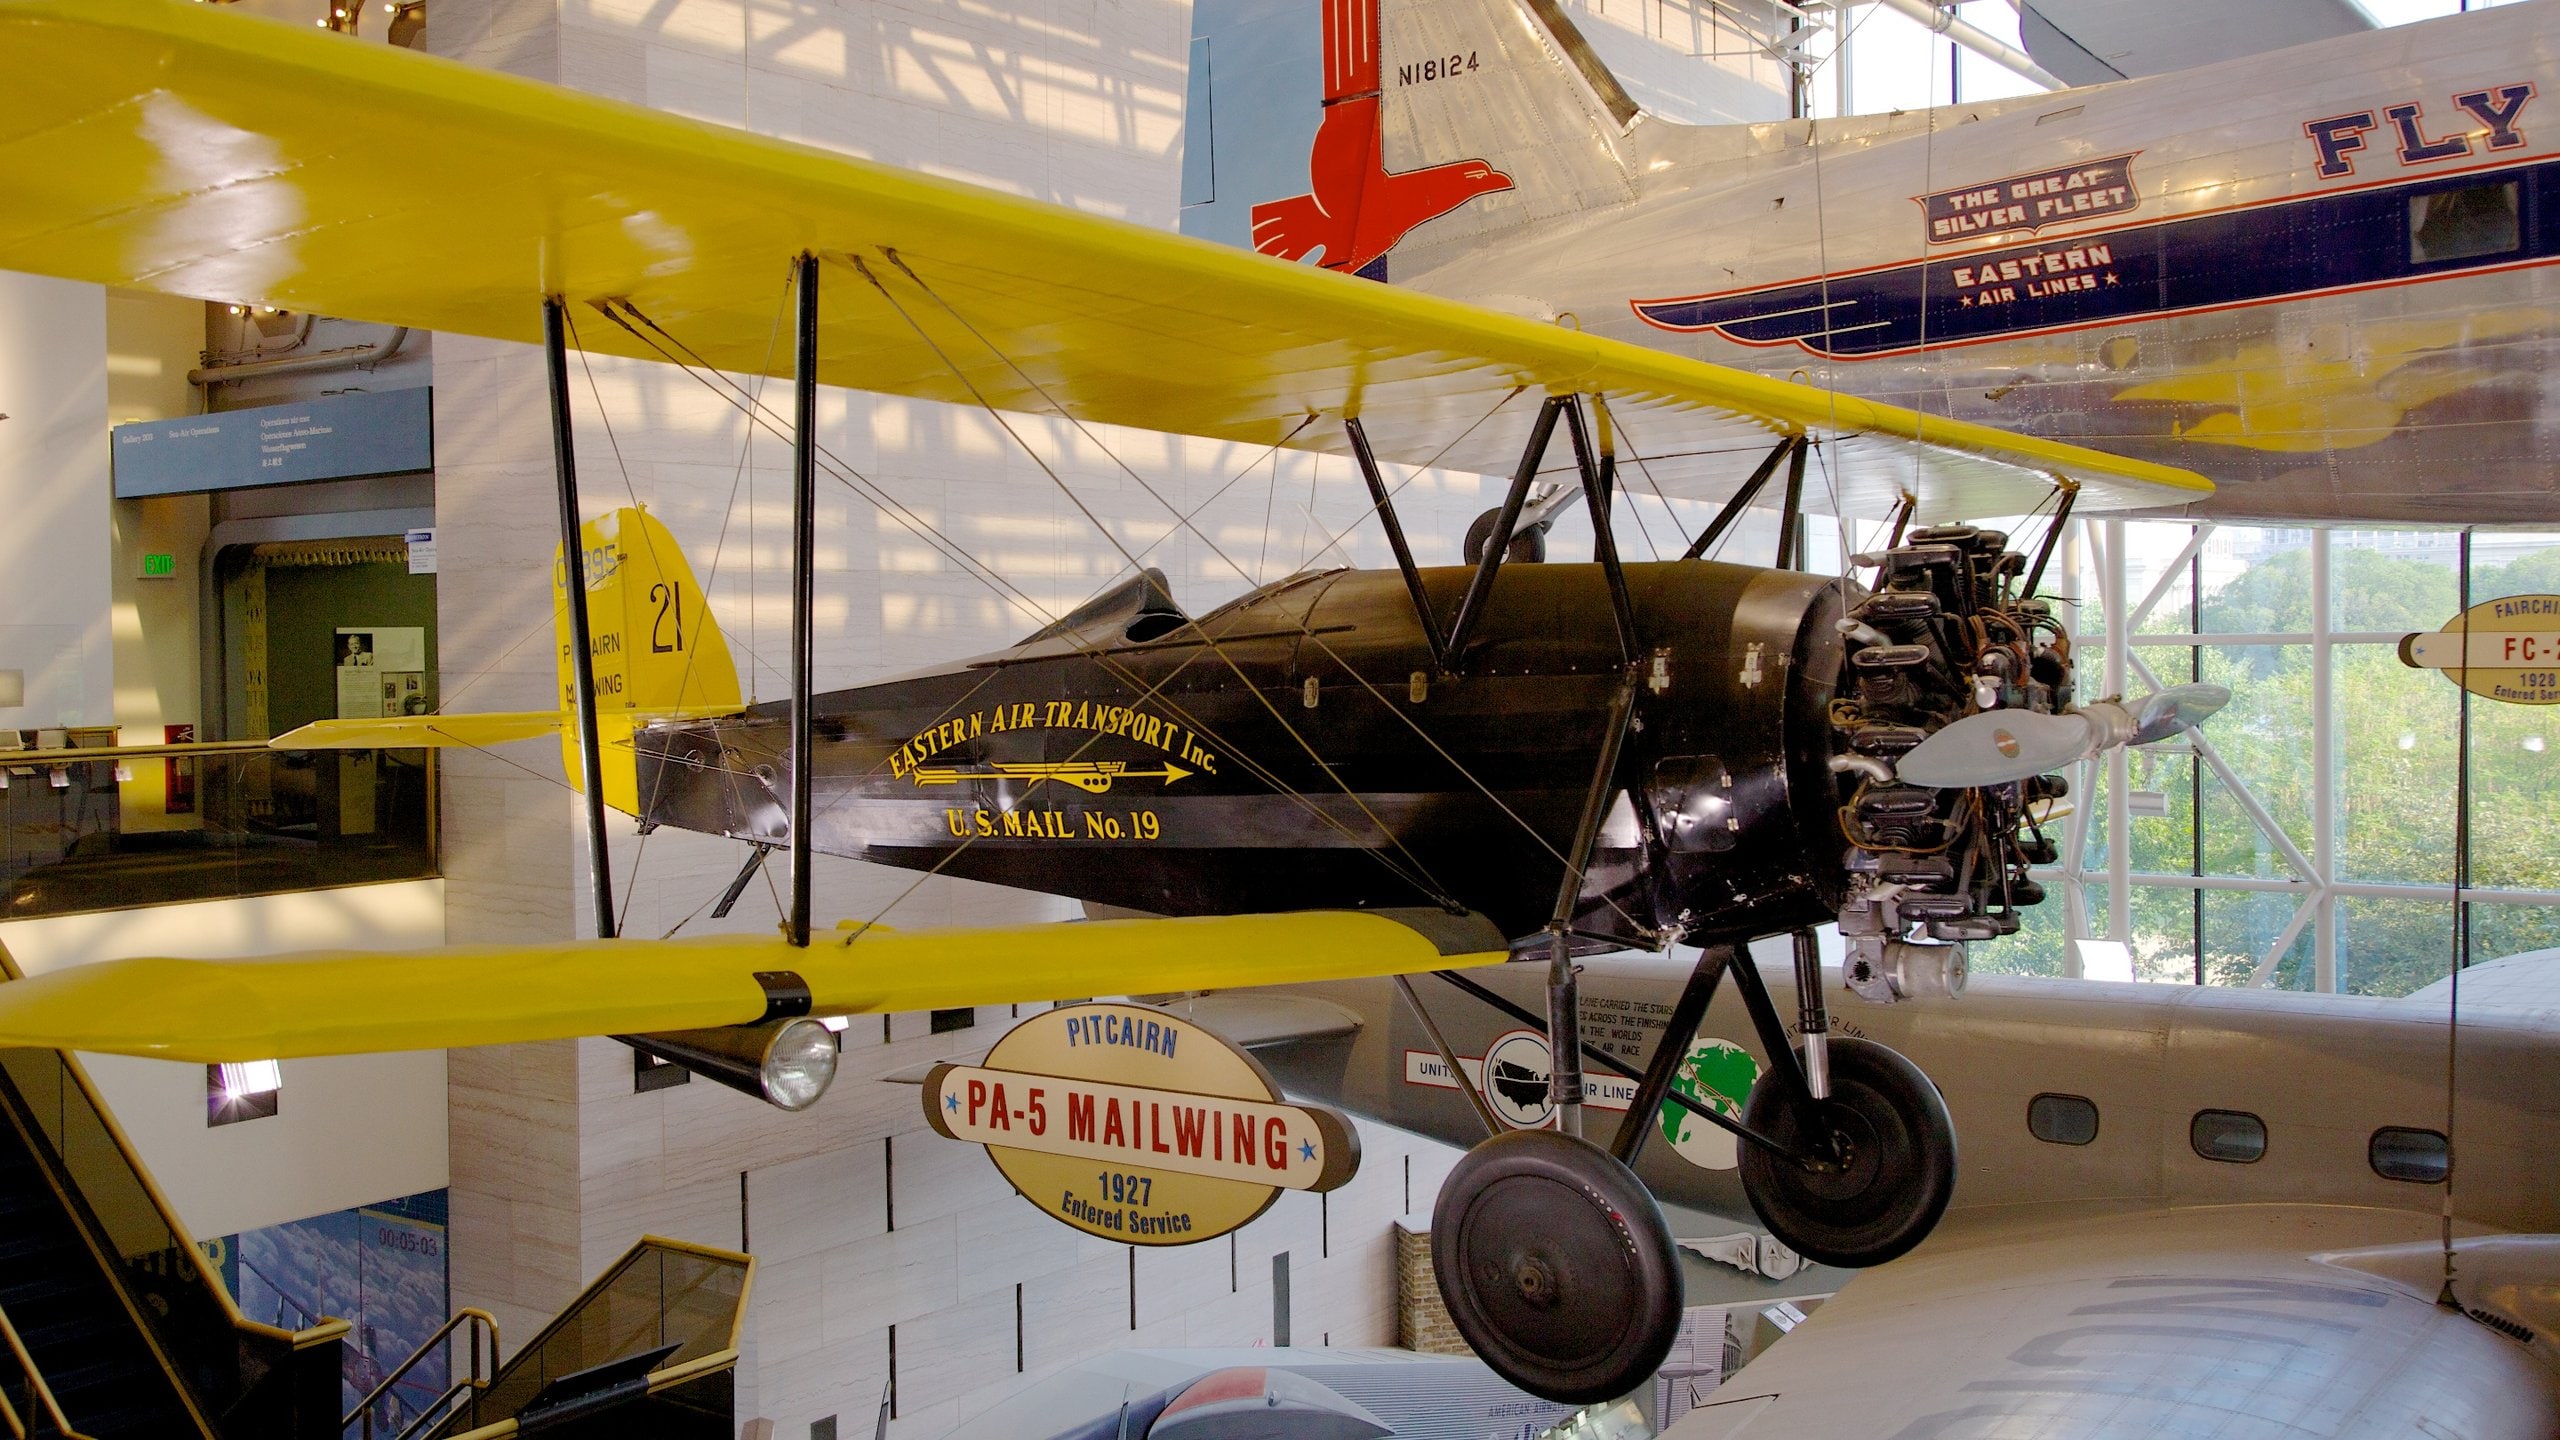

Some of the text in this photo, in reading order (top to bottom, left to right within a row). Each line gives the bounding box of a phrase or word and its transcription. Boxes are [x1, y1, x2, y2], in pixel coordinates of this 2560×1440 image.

[1399, 51, 1480, 87] N18124
[2303, 81, 2538, 180] FLY
[1949, 168, 2100, 211] THE GREAT
[1933, 185, 2127, 237] SILVER FLEET
[1953, 244, 2113, 288] EASTERN
[1978, 273, 2098, 306] AIR LINES
[146, 554, 172, 575] EXIT
[650, 581, 683, 653] 21
[2496, 600, 2560, 618] FAIRCHI
[563, 632, 620, 664] PAIRN
[2494, 685, 2535, 700] Entered
[2520, 673, 2556, 687] 1928
[888, 700, 1218, 780] EASTERN AIR TRANSPORT Inc.
[1003, 810, 1076, 839] MAIL
[1083, 810, 1127, 840] No.
[1129, 810, 1161, 840] 19
[1589, 1012, 1617, 1025] ACROSS
[1620, 1015, 1636, 1027] THE
[1600, 998, 1630, 1011] CARRIED
[1633, 1002, 1649, 1013] THE
[1650, 1003, 1674, 1016] STARS
[1066, 1014, 1179, 1059] PITCAIRN
[1590, 1026, 1606, 1037] THE
[1611, 1028, 1643, 1042] WORLDS
[1621, 1045, 1641, 1057] RACE
[1584, 1082, 1598, 1096] IR
[967, 1078, 1289, 1171] PA-5 MAILWING
[1098, 1171, 1152, 1207] 1927
[1061, 1190, 1192, 1235] Entered Service
[1488, 1402, 1531, 1418] AMERICAN
